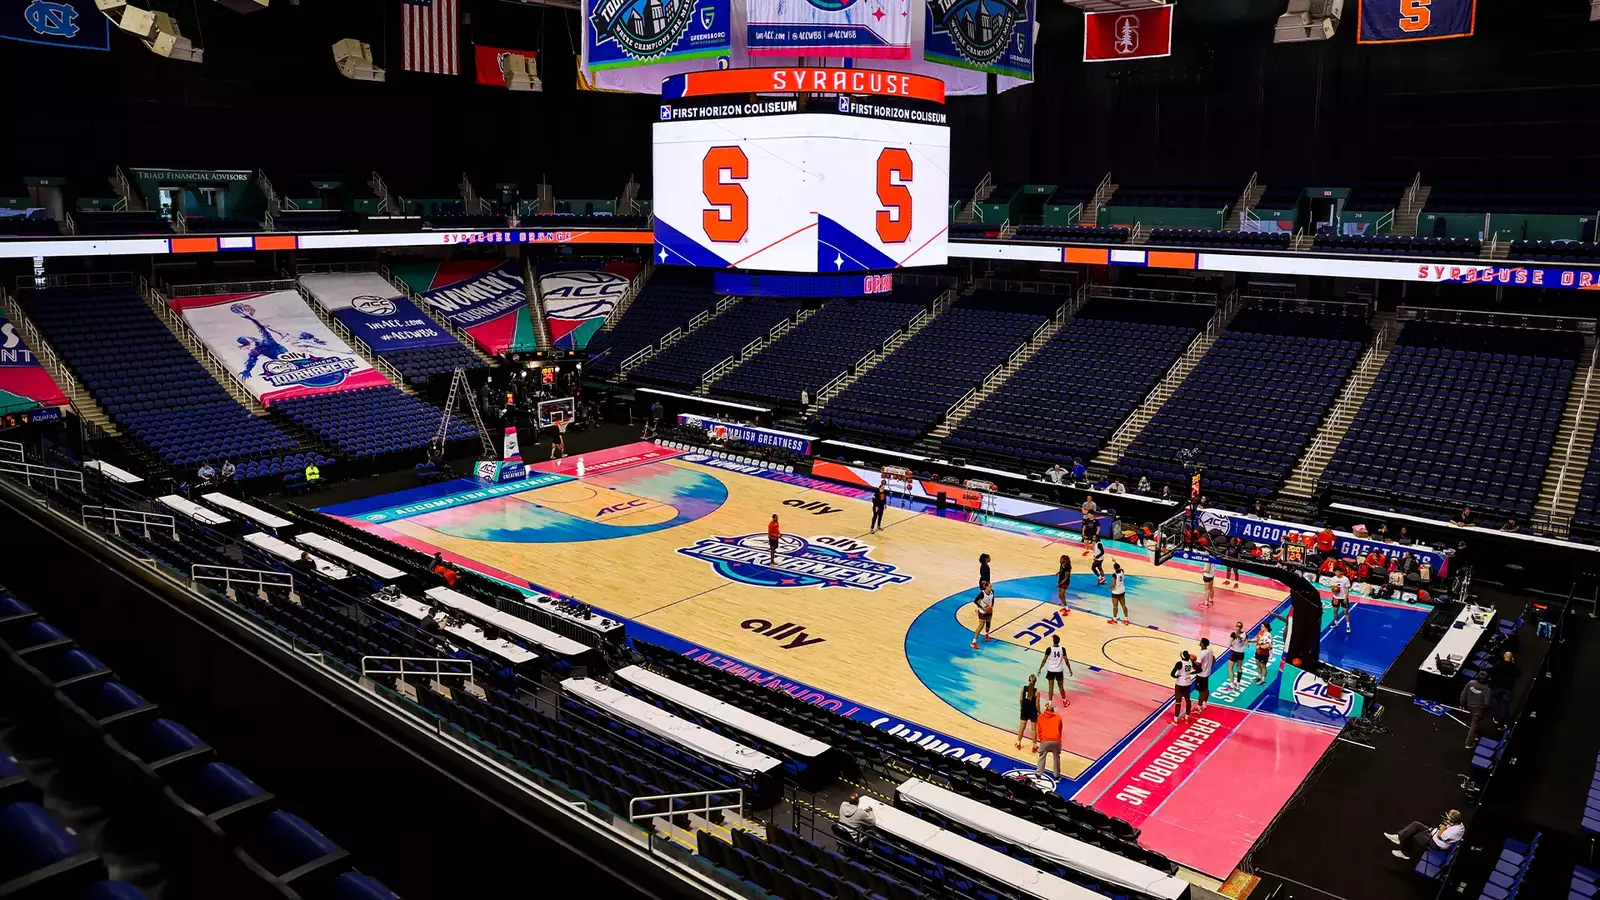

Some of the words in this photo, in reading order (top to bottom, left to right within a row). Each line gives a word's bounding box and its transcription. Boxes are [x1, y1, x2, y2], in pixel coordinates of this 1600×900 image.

[616, 24, 634, 46] WHERE
[634, 34, 671, 51] CHAMPIONS
[690, 32, 726, 41] GREENSBORO
[951, 20, 966, 47] WHERE
[966, 45, 996, 57] CHAMPIONS
[773, 71, 909, 94] SYRACUSE
[673, 107, 698, 119] FIRST
[699, 104, 743, 117] HORIZON
[744, 101, 797, 114] COLISEUM
[851, 103, 872, 114] FIRST
[873, 105, 909, 119] HORIZON
[910, 110, 946, 123] COLISEUM
[138, 171, 164, 180] TRIAD
[166, 171, 209, 180] FINANCIAL
[211, 172, 248, 181] ADVISORS
[703, 145, 748, 243] S
[876, 147, 912, 243] S
[443, 232, 511, 243] SYRACUSE
[1418, 265, 1543, 285] SYRACUSE
[1561, 272, 1600, 286] OR
[424, 269, 525, 312] WOMEN'S
[358, 300, 391, 308] ACC
[449, 289, 528, 324] TOURNAMENT
[280, 352, 306, 361] ally
[268, 358, 356, 386] TOURNAMENT
[543, 373, 554, 383] 29
[757, 431, 803, 451] GREATNESS
[481, 463, 496, 473] ACC
[396, 491, 487, 515] ACCOMPLISH
[487, 475, 562, 495] GREATNESS
[595, 499, 648, 517] ACC
[782, 498, 844, 515] ally
[1203, 517, 1228, 528] ACC
[816, 536, 870, 551] ally
[691, 542, 906, 589] TOURNAMENT
[802, 552, 889, 572] WOMEN'S
[1290, 552, 1301, 560] 29
[740, 618, 827, 650] ally
[1013, 611, 1065, 646] ACC
[1115, 784, 1152, 807] NC
